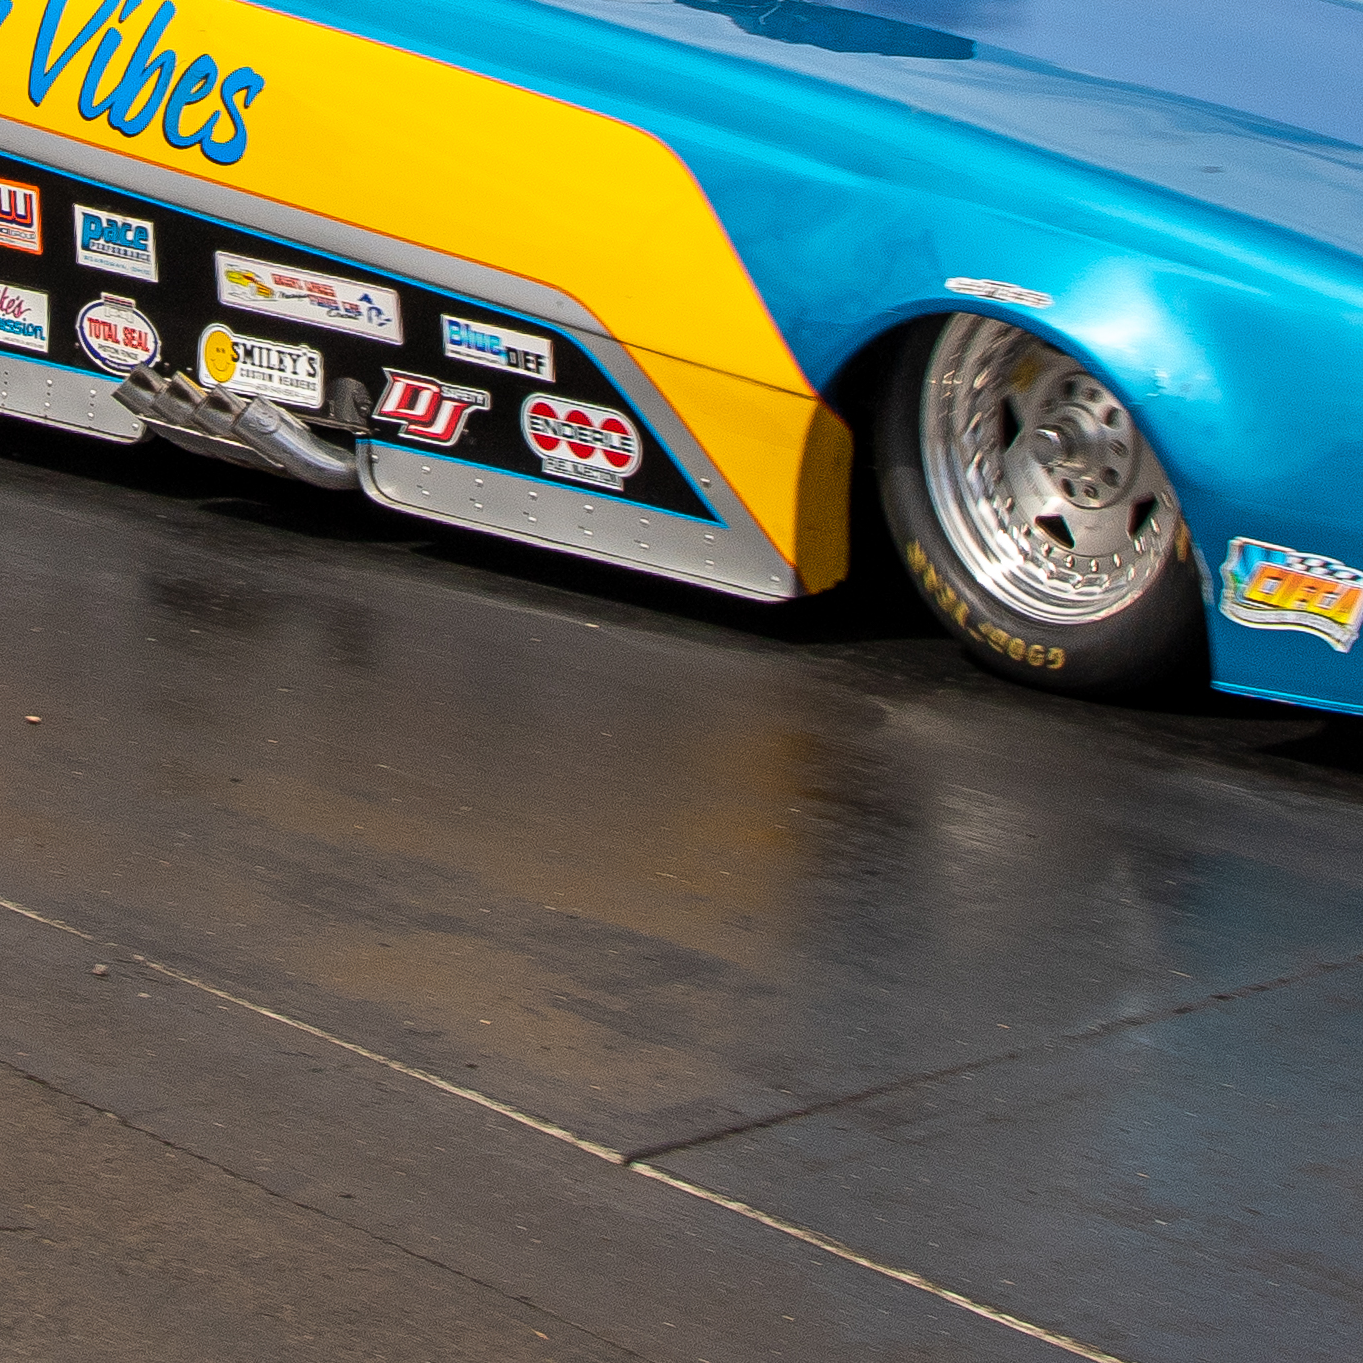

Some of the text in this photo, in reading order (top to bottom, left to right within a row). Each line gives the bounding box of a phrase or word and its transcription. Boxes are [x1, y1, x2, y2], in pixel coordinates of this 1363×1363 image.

[81, 212, 148, 251] pace
[86, 317, 150, 354] TOTAL SEAL
[380, 374, 471, 441] DJ
[529, 414, 635, 456] ENDERLE
